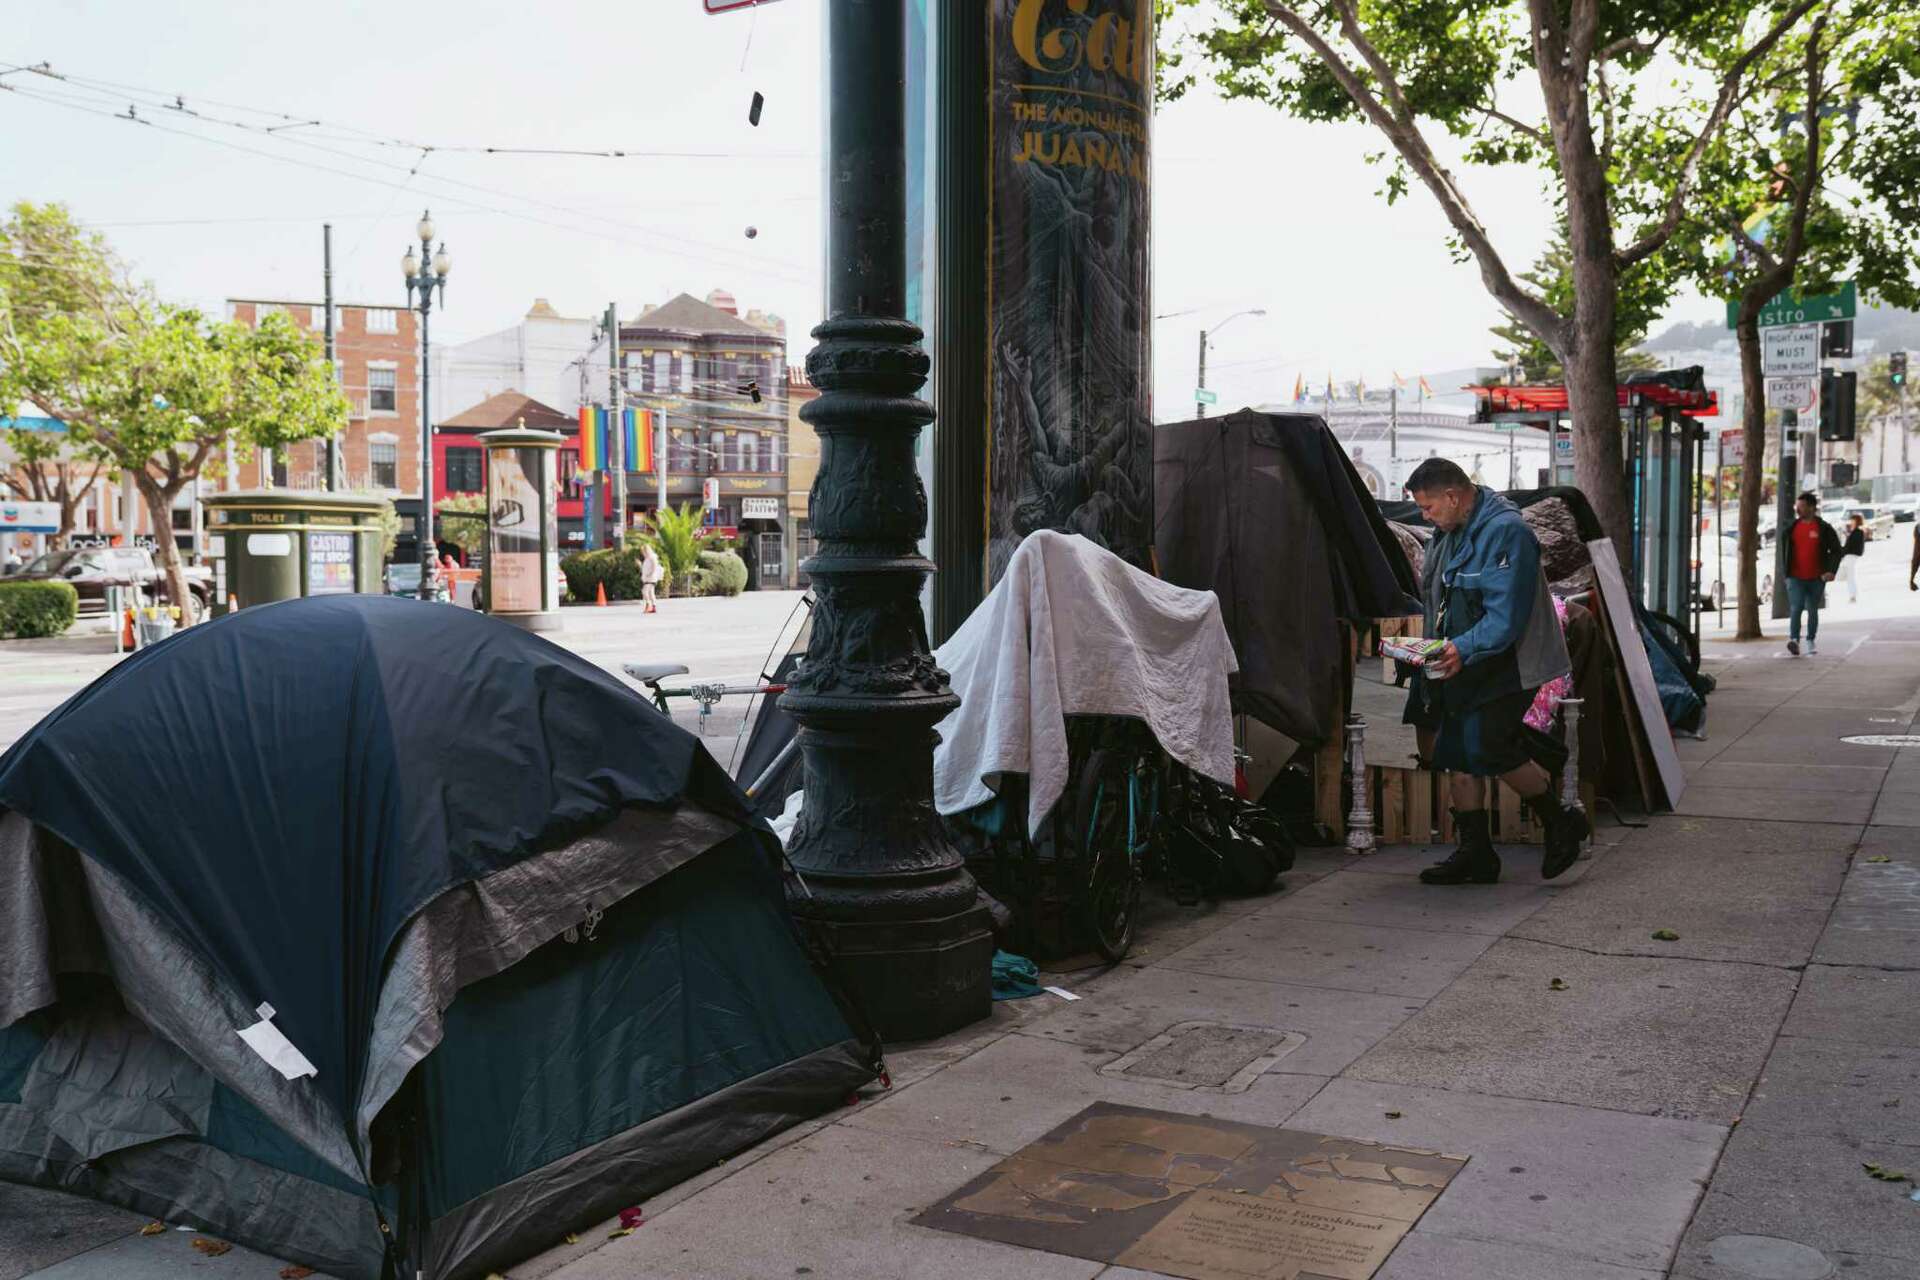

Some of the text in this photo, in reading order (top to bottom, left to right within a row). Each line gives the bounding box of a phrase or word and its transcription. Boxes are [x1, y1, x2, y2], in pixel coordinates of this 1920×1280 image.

[1013, 102, 1047, 122] THE
[1012, 131, 1125, 177] JUANA
[1767, 333, 1814, 343] RIGHT LANE
[1776, 347, 1806, 358] MUST
[1767, 361, 1814, 371] TURN RIGHT
[1771, 382, 1807, 391] EXCEPT
[251, 513, 285, 523] TOILET
[311, 535, 350, 551] CASTRO
[311, 552, 350, 563] PIT STOP
